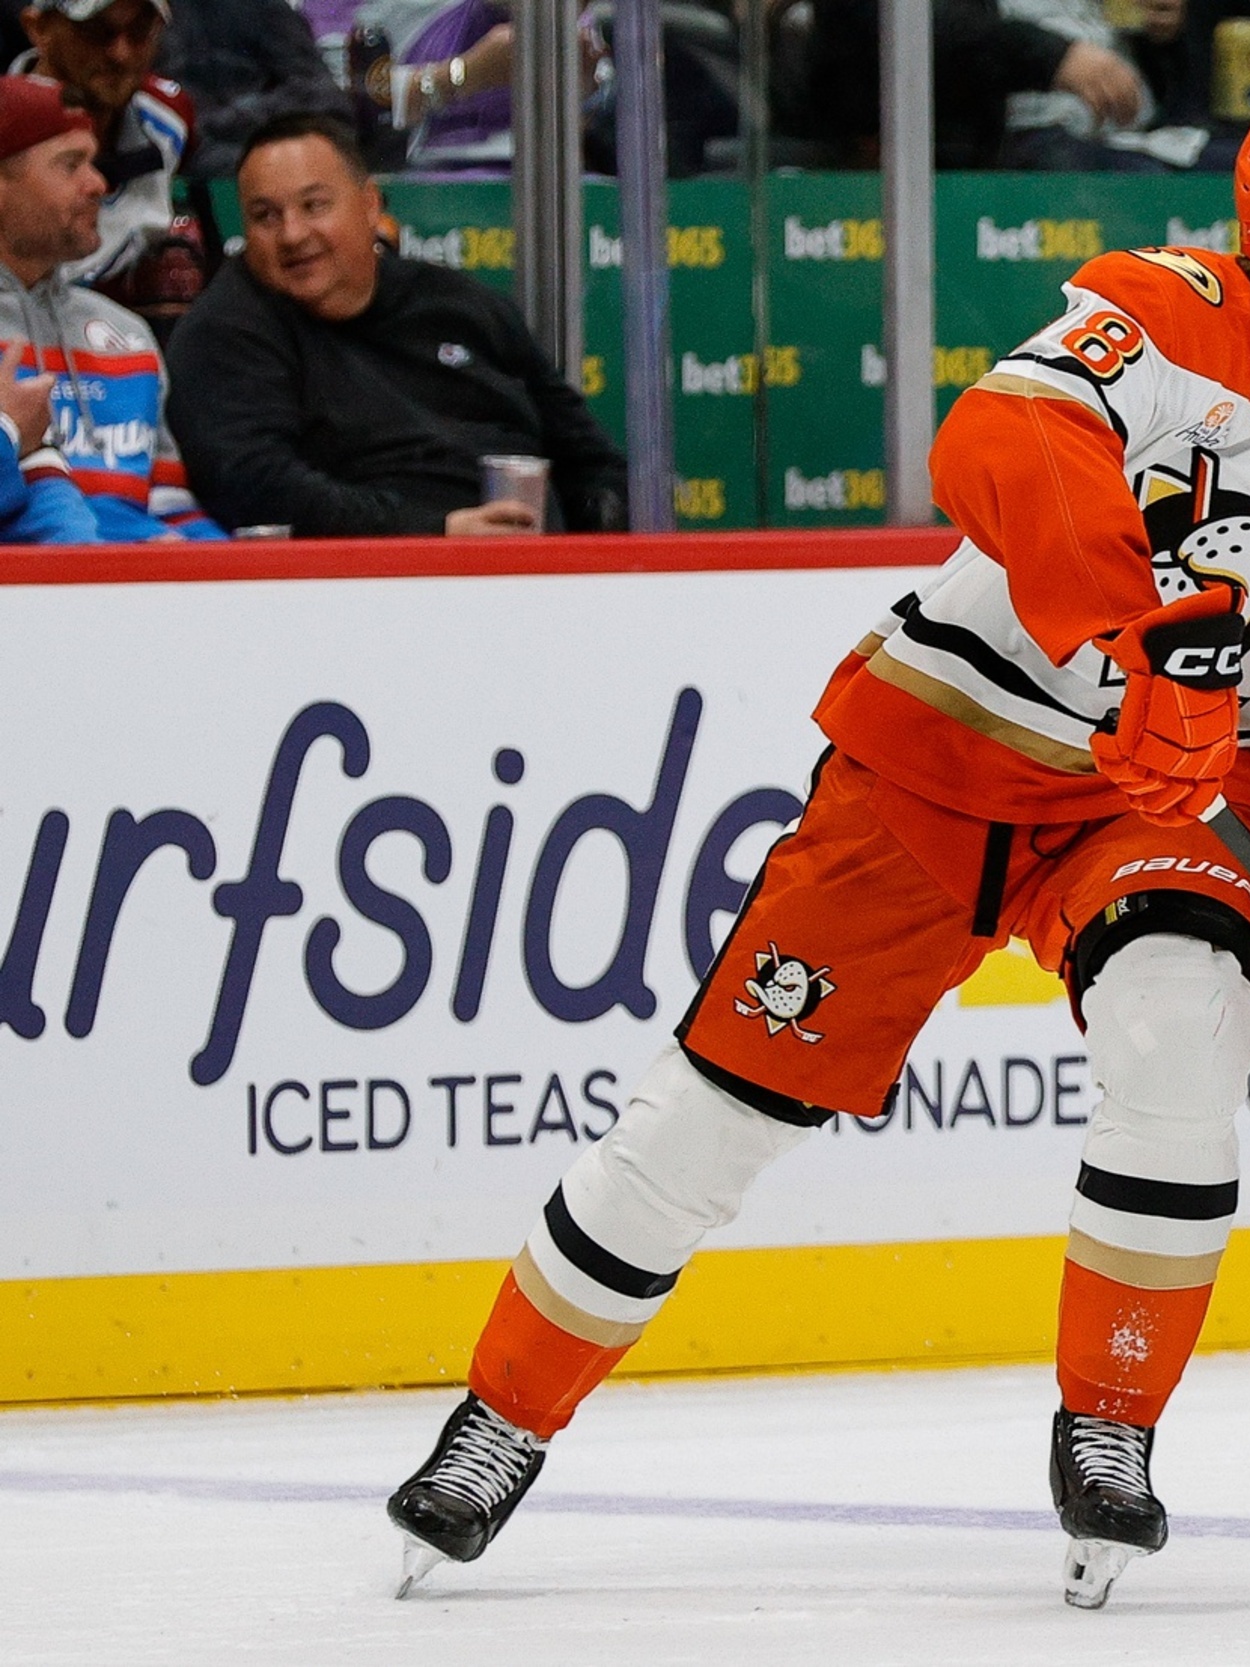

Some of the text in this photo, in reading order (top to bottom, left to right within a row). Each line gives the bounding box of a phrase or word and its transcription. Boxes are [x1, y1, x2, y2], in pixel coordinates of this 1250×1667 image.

[784, 215, 885, 260] bet36
[247, 1078, 412, 1156] ICED
[430, 1069, 620, 1148] TEAS
